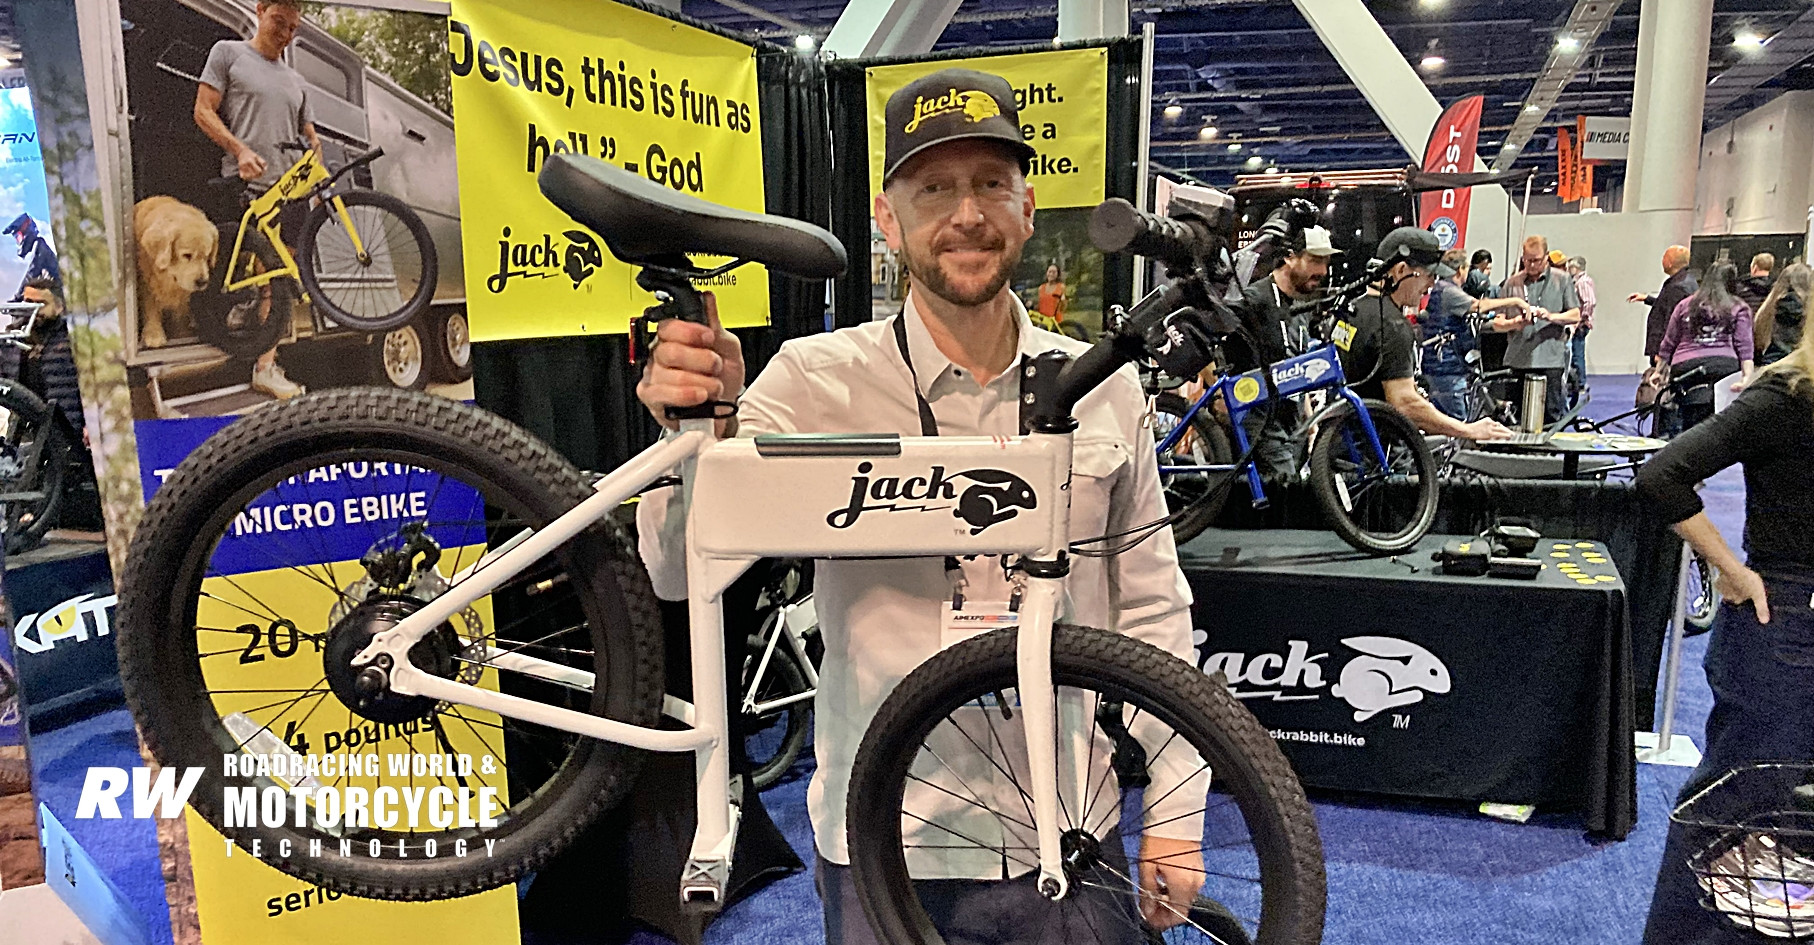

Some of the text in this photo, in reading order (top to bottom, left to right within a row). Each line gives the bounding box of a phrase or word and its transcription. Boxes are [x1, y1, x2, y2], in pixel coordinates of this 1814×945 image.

[450, 20, 752, 134] Jesus, this is fun as
[1013, 83, 1064, 111] ght.
[905, 89, 966, 134] jack
[1022, 122, 1057, 140] e a
[1596, 131, 1621, 143] MEDIA
[645, 143, 703, 192] God
[1030, 154, 1079, 176] ike.
[1238, 230, 1258, 239] LON
[487, 226, 561, 293] jack
[233, 491, 428, 536] MICRO EBIKE
[826, 461, 958, 529] jack
[235, 618, 299, 665] 20
[1268, 728, 1366, 747] ckrabbit.bike
